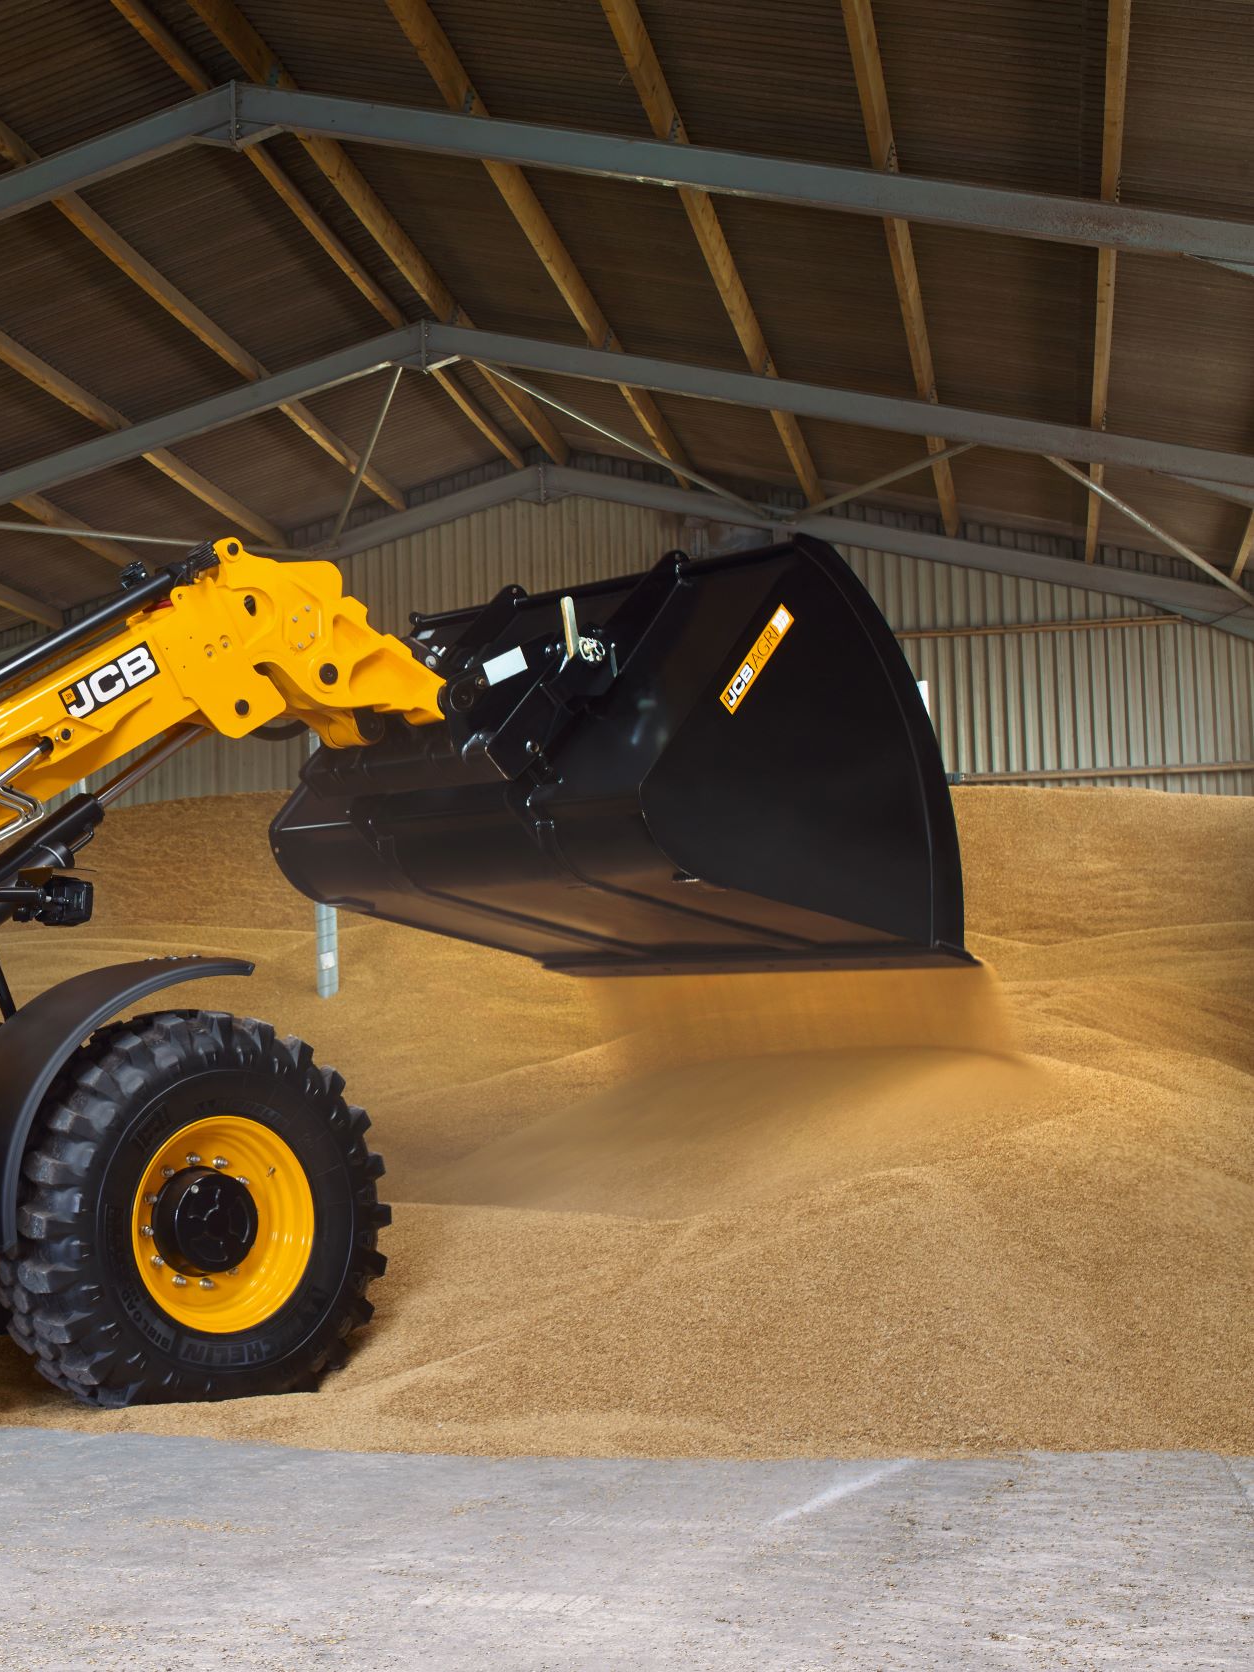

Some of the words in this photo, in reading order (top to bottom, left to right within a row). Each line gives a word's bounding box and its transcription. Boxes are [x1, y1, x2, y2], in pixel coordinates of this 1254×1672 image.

[68, 647, 156, 718] JCB
[728, 663, 755, 707] JCB
[752, 625, 780, 670] AGRI
[182, 1338, 281, 1365] CHELIN
